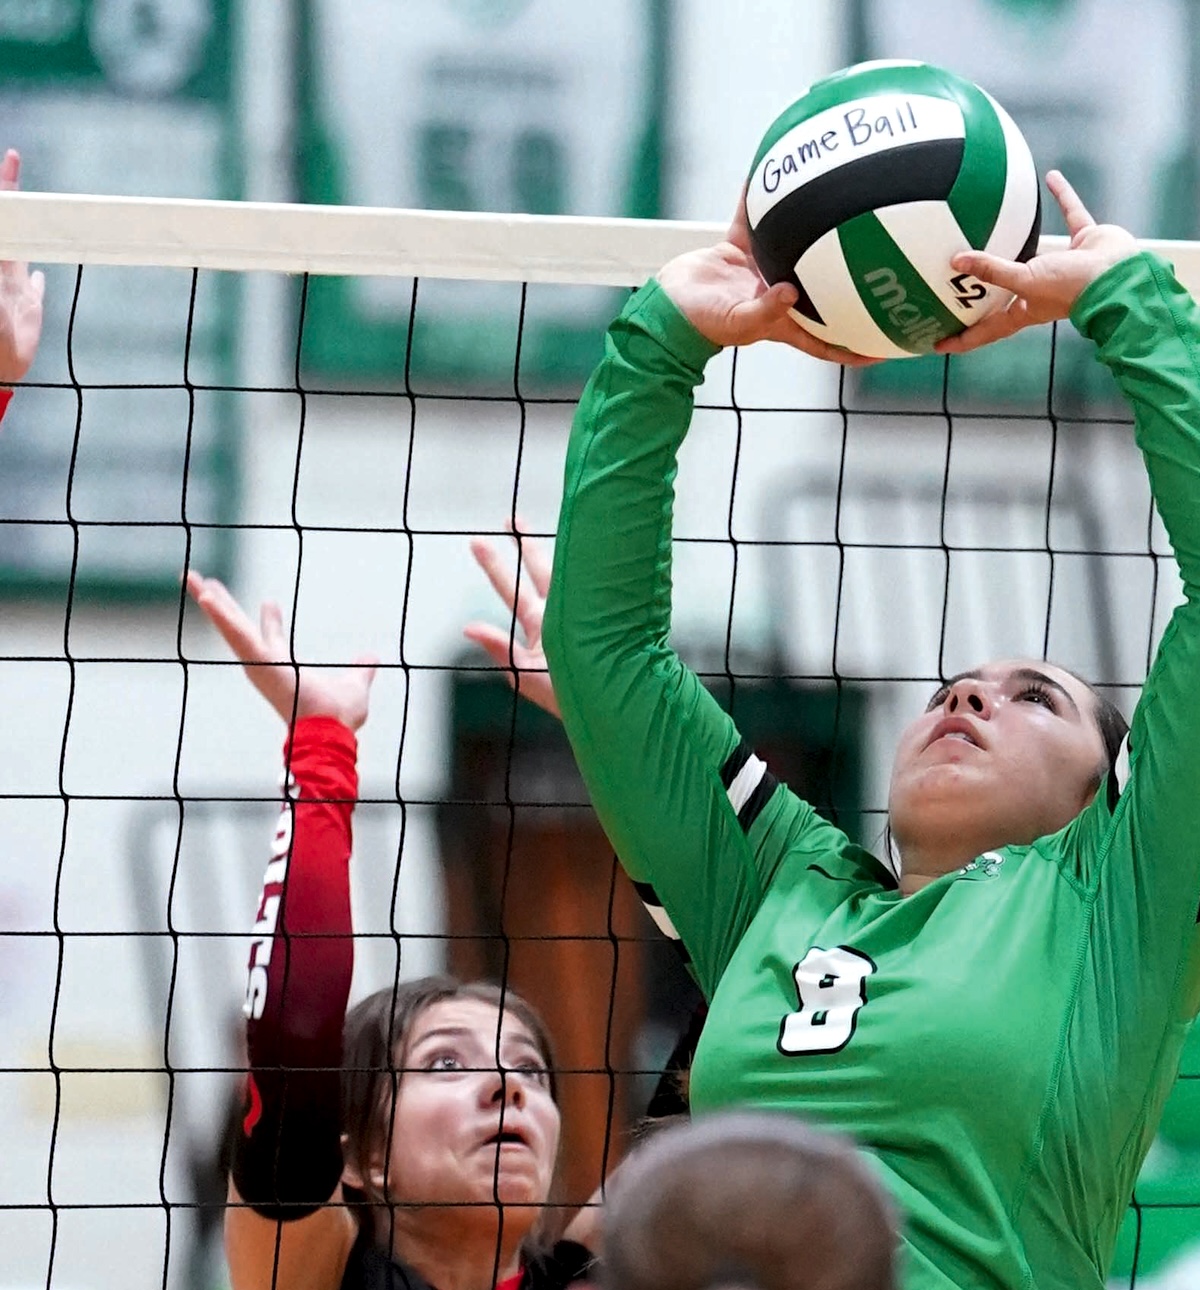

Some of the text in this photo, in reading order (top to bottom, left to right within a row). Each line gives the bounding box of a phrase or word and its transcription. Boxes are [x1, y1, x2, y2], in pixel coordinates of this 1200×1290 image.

[762, 101, 918, 193] Game Ball
[776, 944, 878, 1057] 8
